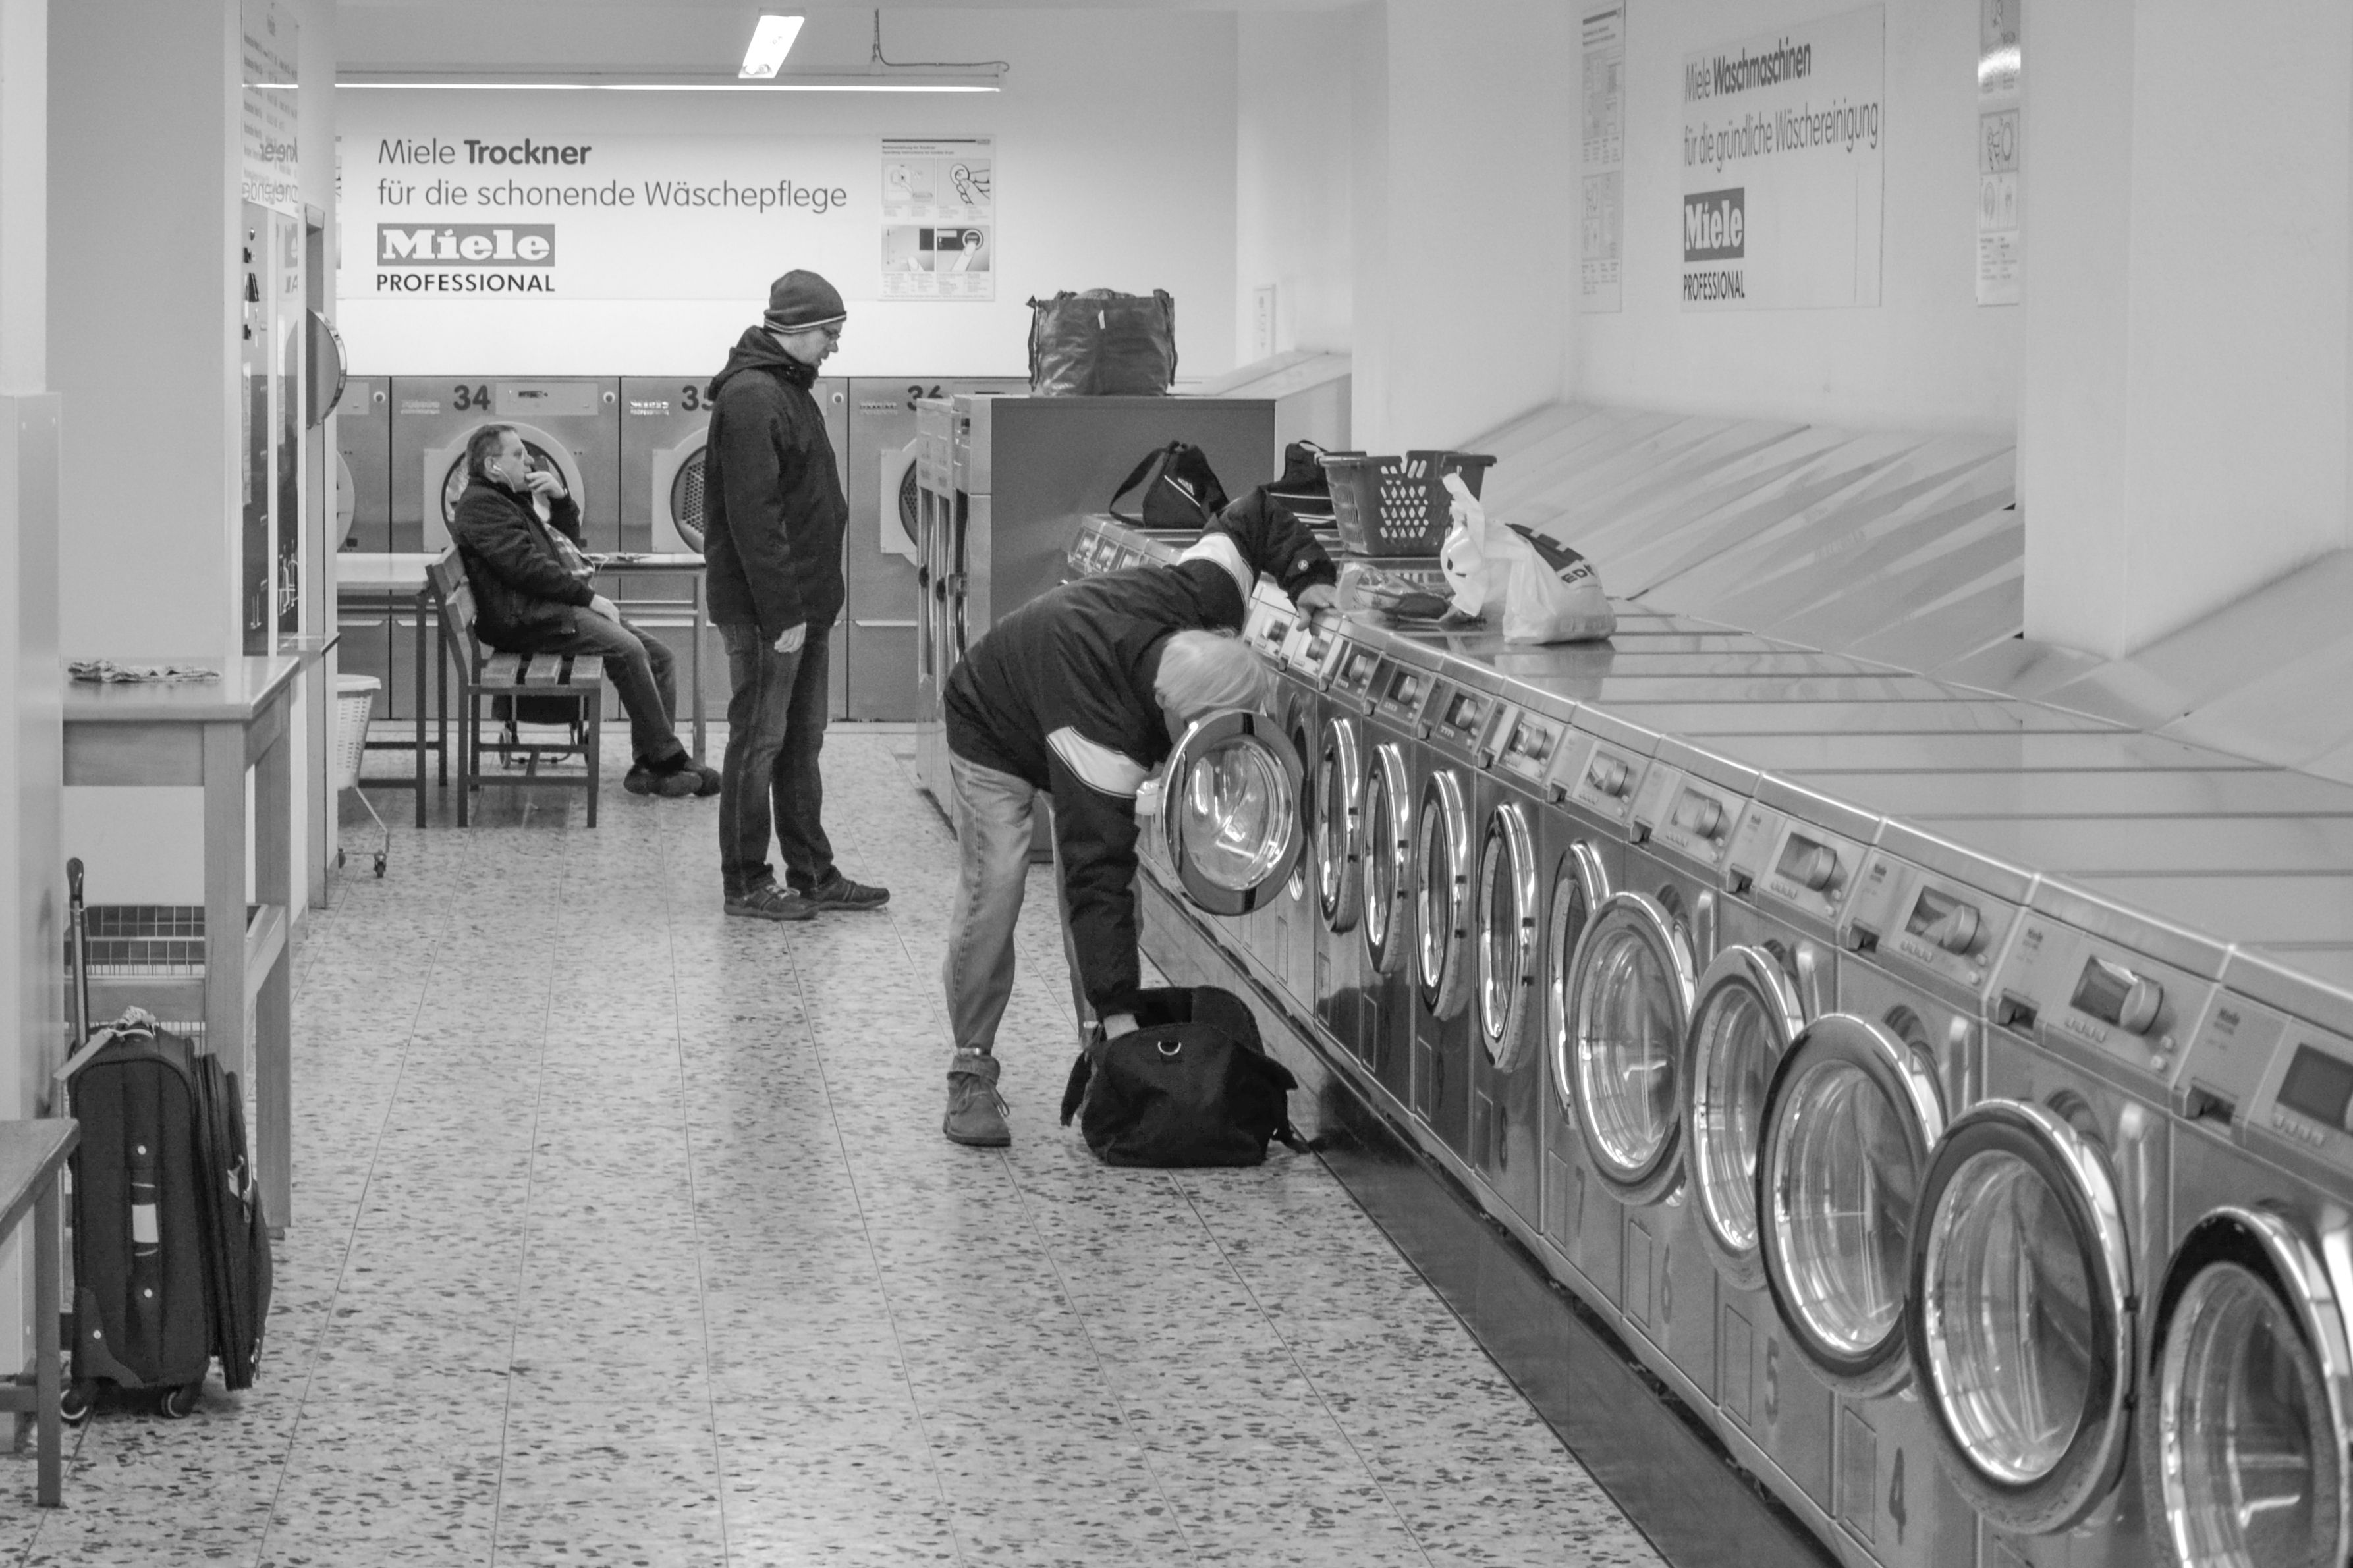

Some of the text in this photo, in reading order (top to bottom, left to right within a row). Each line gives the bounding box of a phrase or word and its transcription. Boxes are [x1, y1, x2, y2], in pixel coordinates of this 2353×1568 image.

[1685, 36, 1811, 103] Miele Waschmaschinen
[378, 138, 592, 165] Miele Trockner
[1684, 98, 1878, 173] für die gründliche Wäschereinigung
[377, 178, 847, 214] für die schonende Wäschepflege
[382, 229, 551, 261] Miele
[1684, 199, 1744, 251] Miele
[376, 274, 555, 292] PROFESSIONAL
[1684, 270, 1745, 301] PROFESSIONAL
[453, 385, 491, 411] 34
[1499, 1105, 1508, 1172] 8
[1660, 1243, 1673, 1324] 6
[1765, 1336, 1779, 1425] 5
[1889, 1446, 1906, 1546] 4
